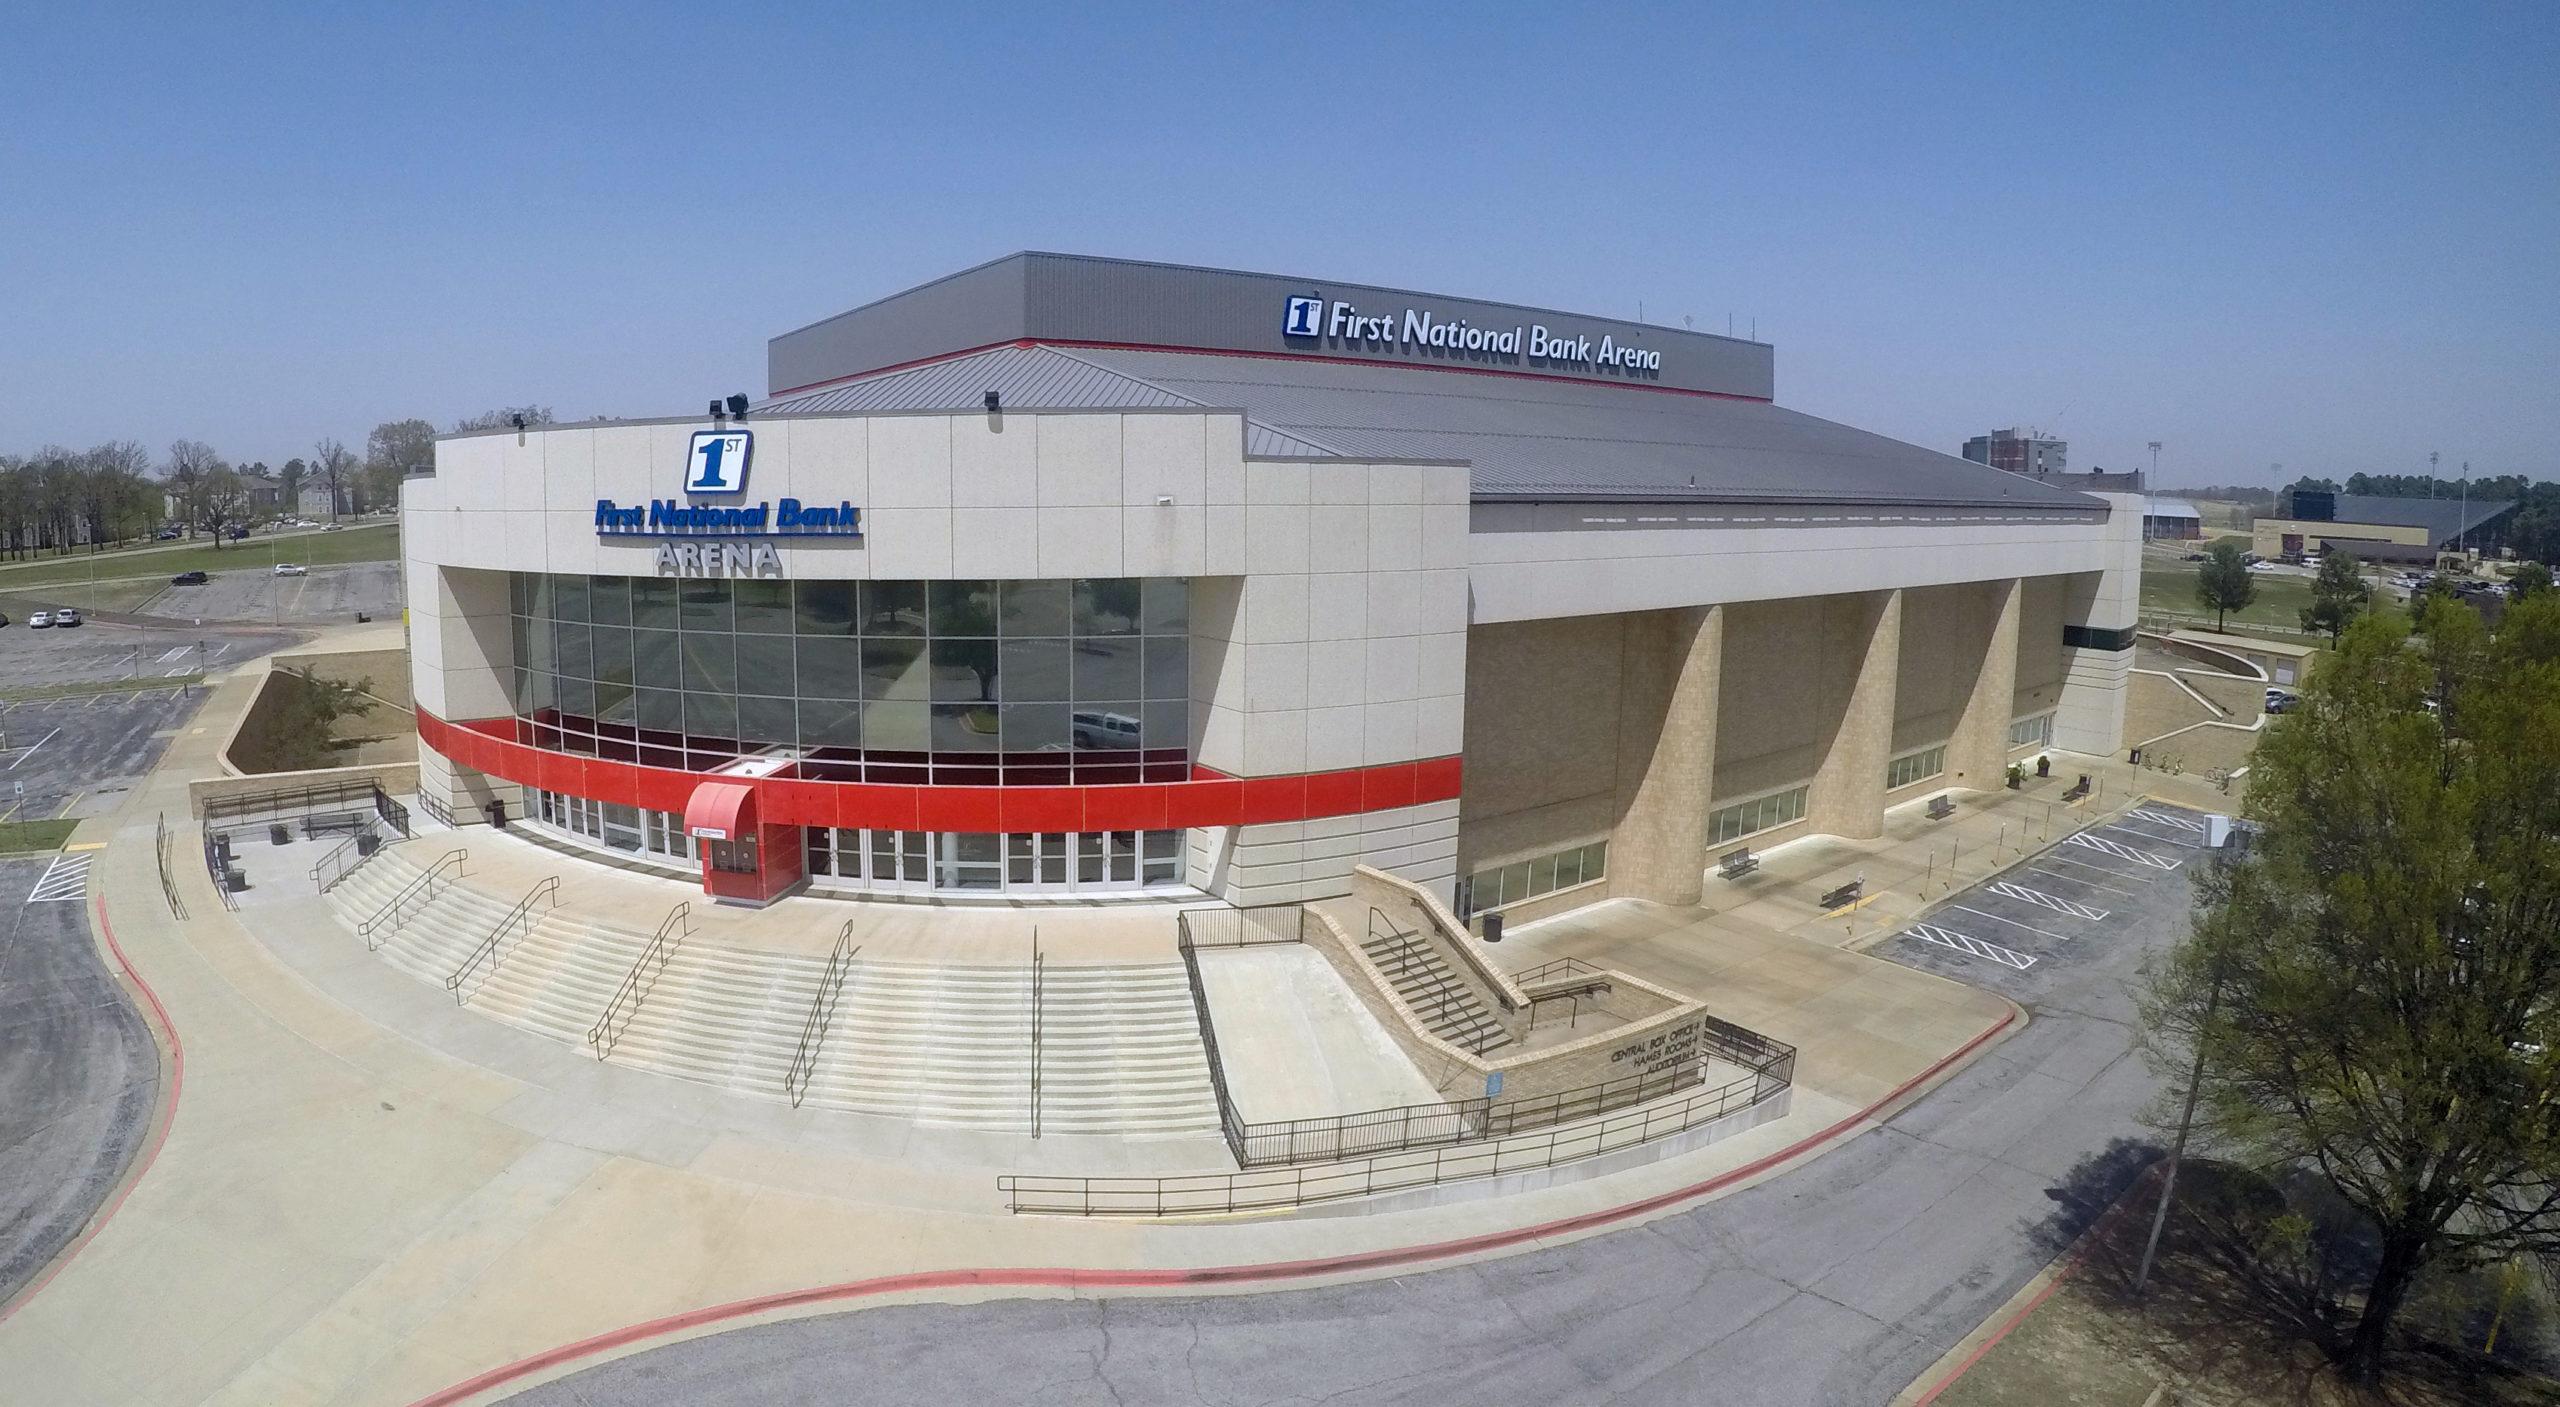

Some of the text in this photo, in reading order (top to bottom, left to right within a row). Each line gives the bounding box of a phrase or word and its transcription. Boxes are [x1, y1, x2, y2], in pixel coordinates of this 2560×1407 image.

[1329, 301, 1394, 342] First
[1402, 308, 1521, 355] National
[1529, 324, 1591, 362] Bank
[1597, 335, 1661, 371] Arena
[595, 498, 860, 528] First National Bank
[656, 543, 782, 569] ARENA
[1611, 1041, 1646, 1062] CENTRAL
[1650, 1034, 1666, 1049] BOX
